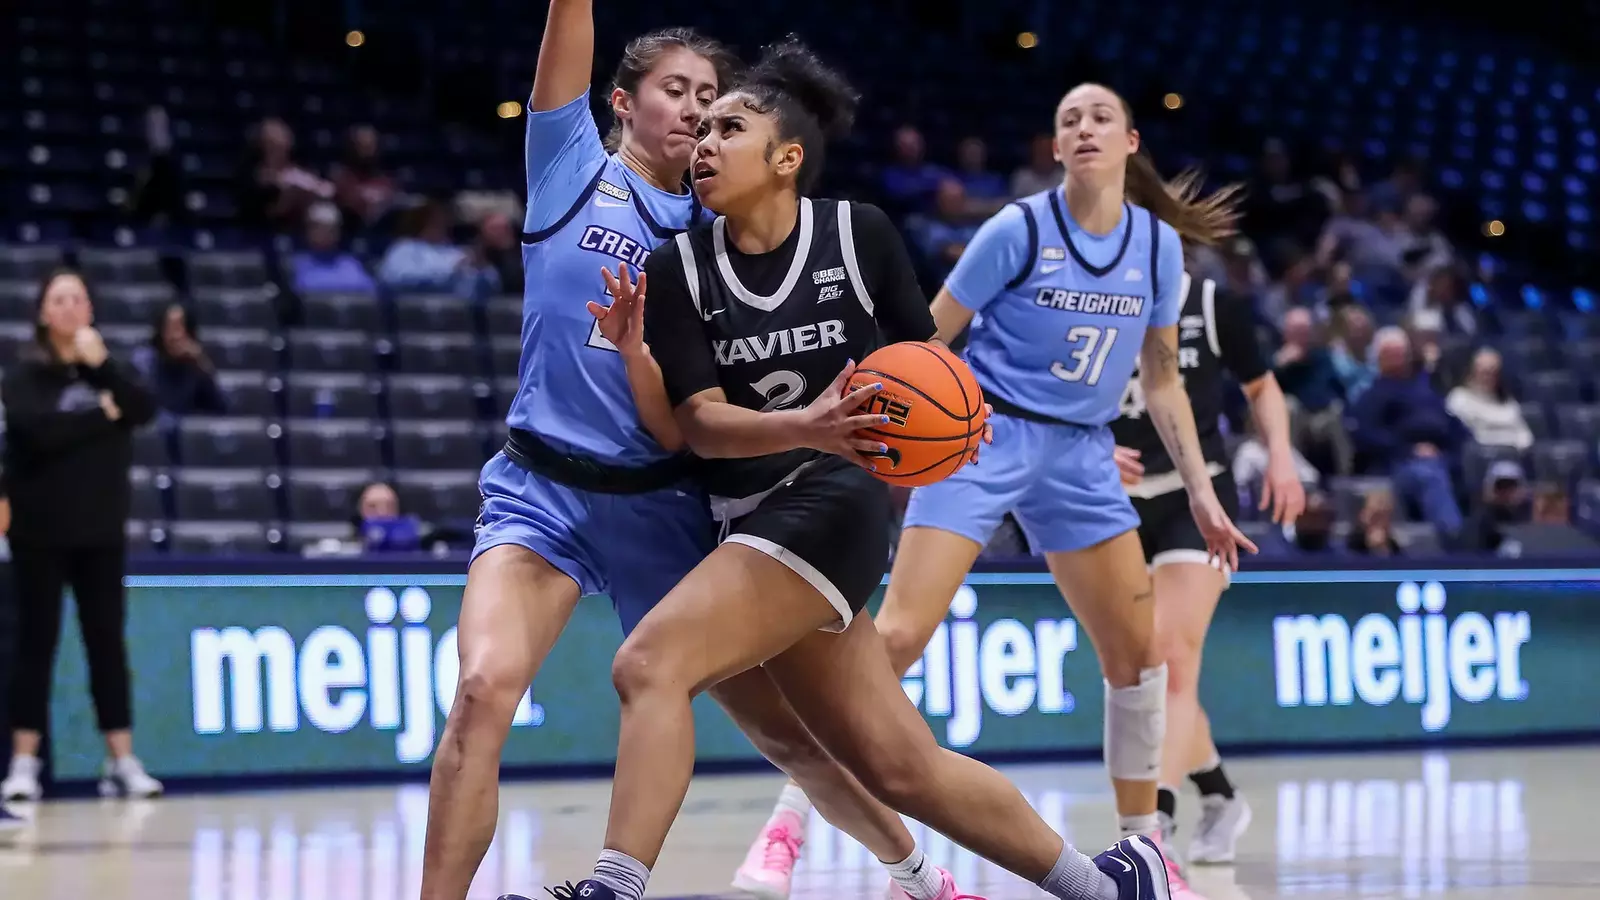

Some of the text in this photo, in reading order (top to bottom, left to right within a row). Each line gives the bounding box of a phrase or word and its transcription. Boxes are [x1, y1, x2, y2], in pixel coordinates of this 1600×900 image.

[814, 274, 845, 284] CHANGE
[817, 290, 844, 300] EAST
[820, 284, 839, 294] BIG
[1036, 288, 1145, 317] CREIGHTON
[712, 319, 848, 366] XAVIER
[1049, 326, 1119, 387] 31
[749, 369, 808, 414] 2
[190, 586, 536, 764] meij
[901, 585, 1077, 748] ijer
[1273, 579, 1531, 732] meijer
